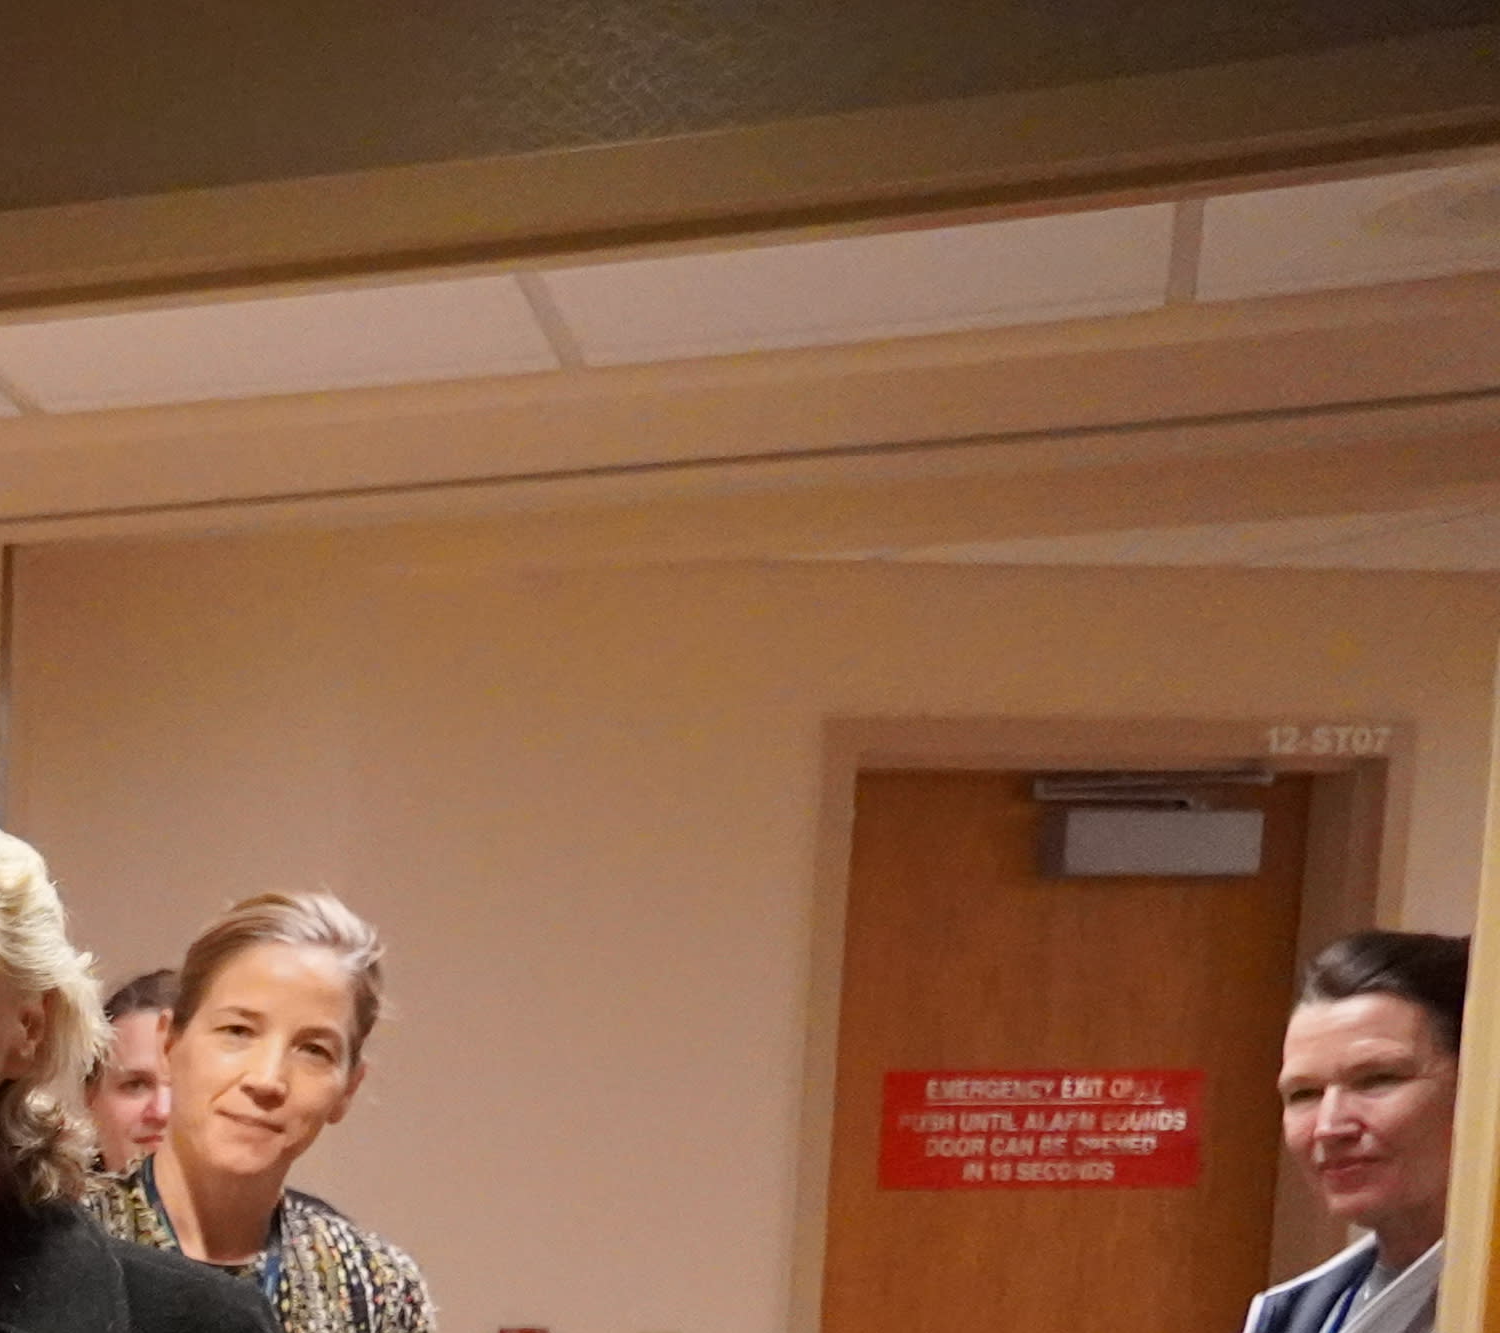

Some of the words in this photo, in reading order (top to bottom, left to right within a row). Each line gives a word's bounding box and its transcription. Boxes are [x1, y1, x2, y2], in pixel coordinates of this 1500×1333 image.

[926, 1079, 1052, 1100] EMERGENCY
[1061, 1077, 1104, 1098] EXIT
[960, 1113, 1018, 1132] UNTIL
[1024, 1113, 1096, 1131] ALARM
[1101, 1110, 1187, 1131] SOUNDS
[925, 1138, 985, 1157] DOOR
[990, 1138, 1034, 1156] CAN
[1039, 1138, 1067, 1156] BE
[963, 1163, 984, 1180] IN
[1017, 1162, 1114, 1181] SECONDS
